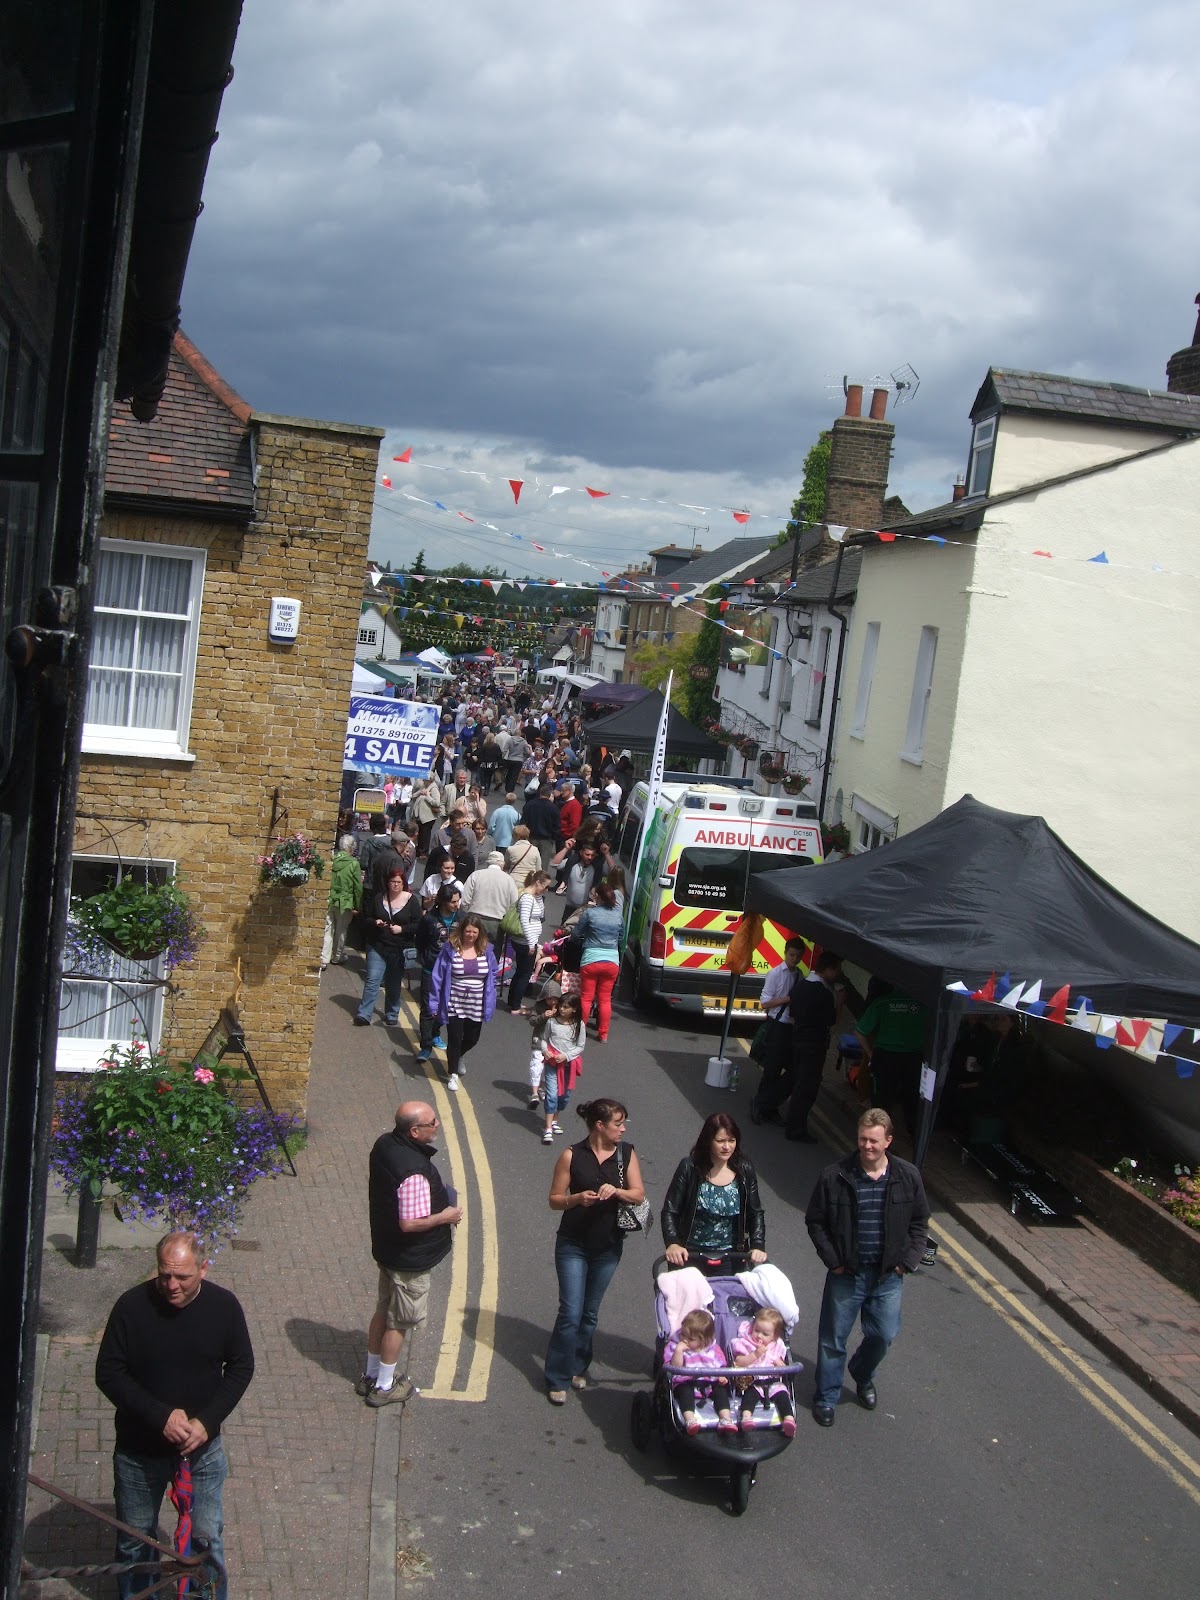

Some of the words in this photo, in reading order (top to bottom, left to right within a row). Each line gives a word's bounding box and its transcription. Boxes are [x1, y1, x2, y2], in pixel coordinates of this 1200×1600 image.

[354, 709, 407, 726] Martin
[353, 725, 385, 737] 01375
[388, 730, 426, 742] 891007
[344, 737, 356, 759] 4
[364, 739, 432, 768] SALE
[694, 829, 807, 852] AMBULANCE
[793, 829, 813, 837] DC150
[688, 883, 727, 892] www.sja.org.uk
